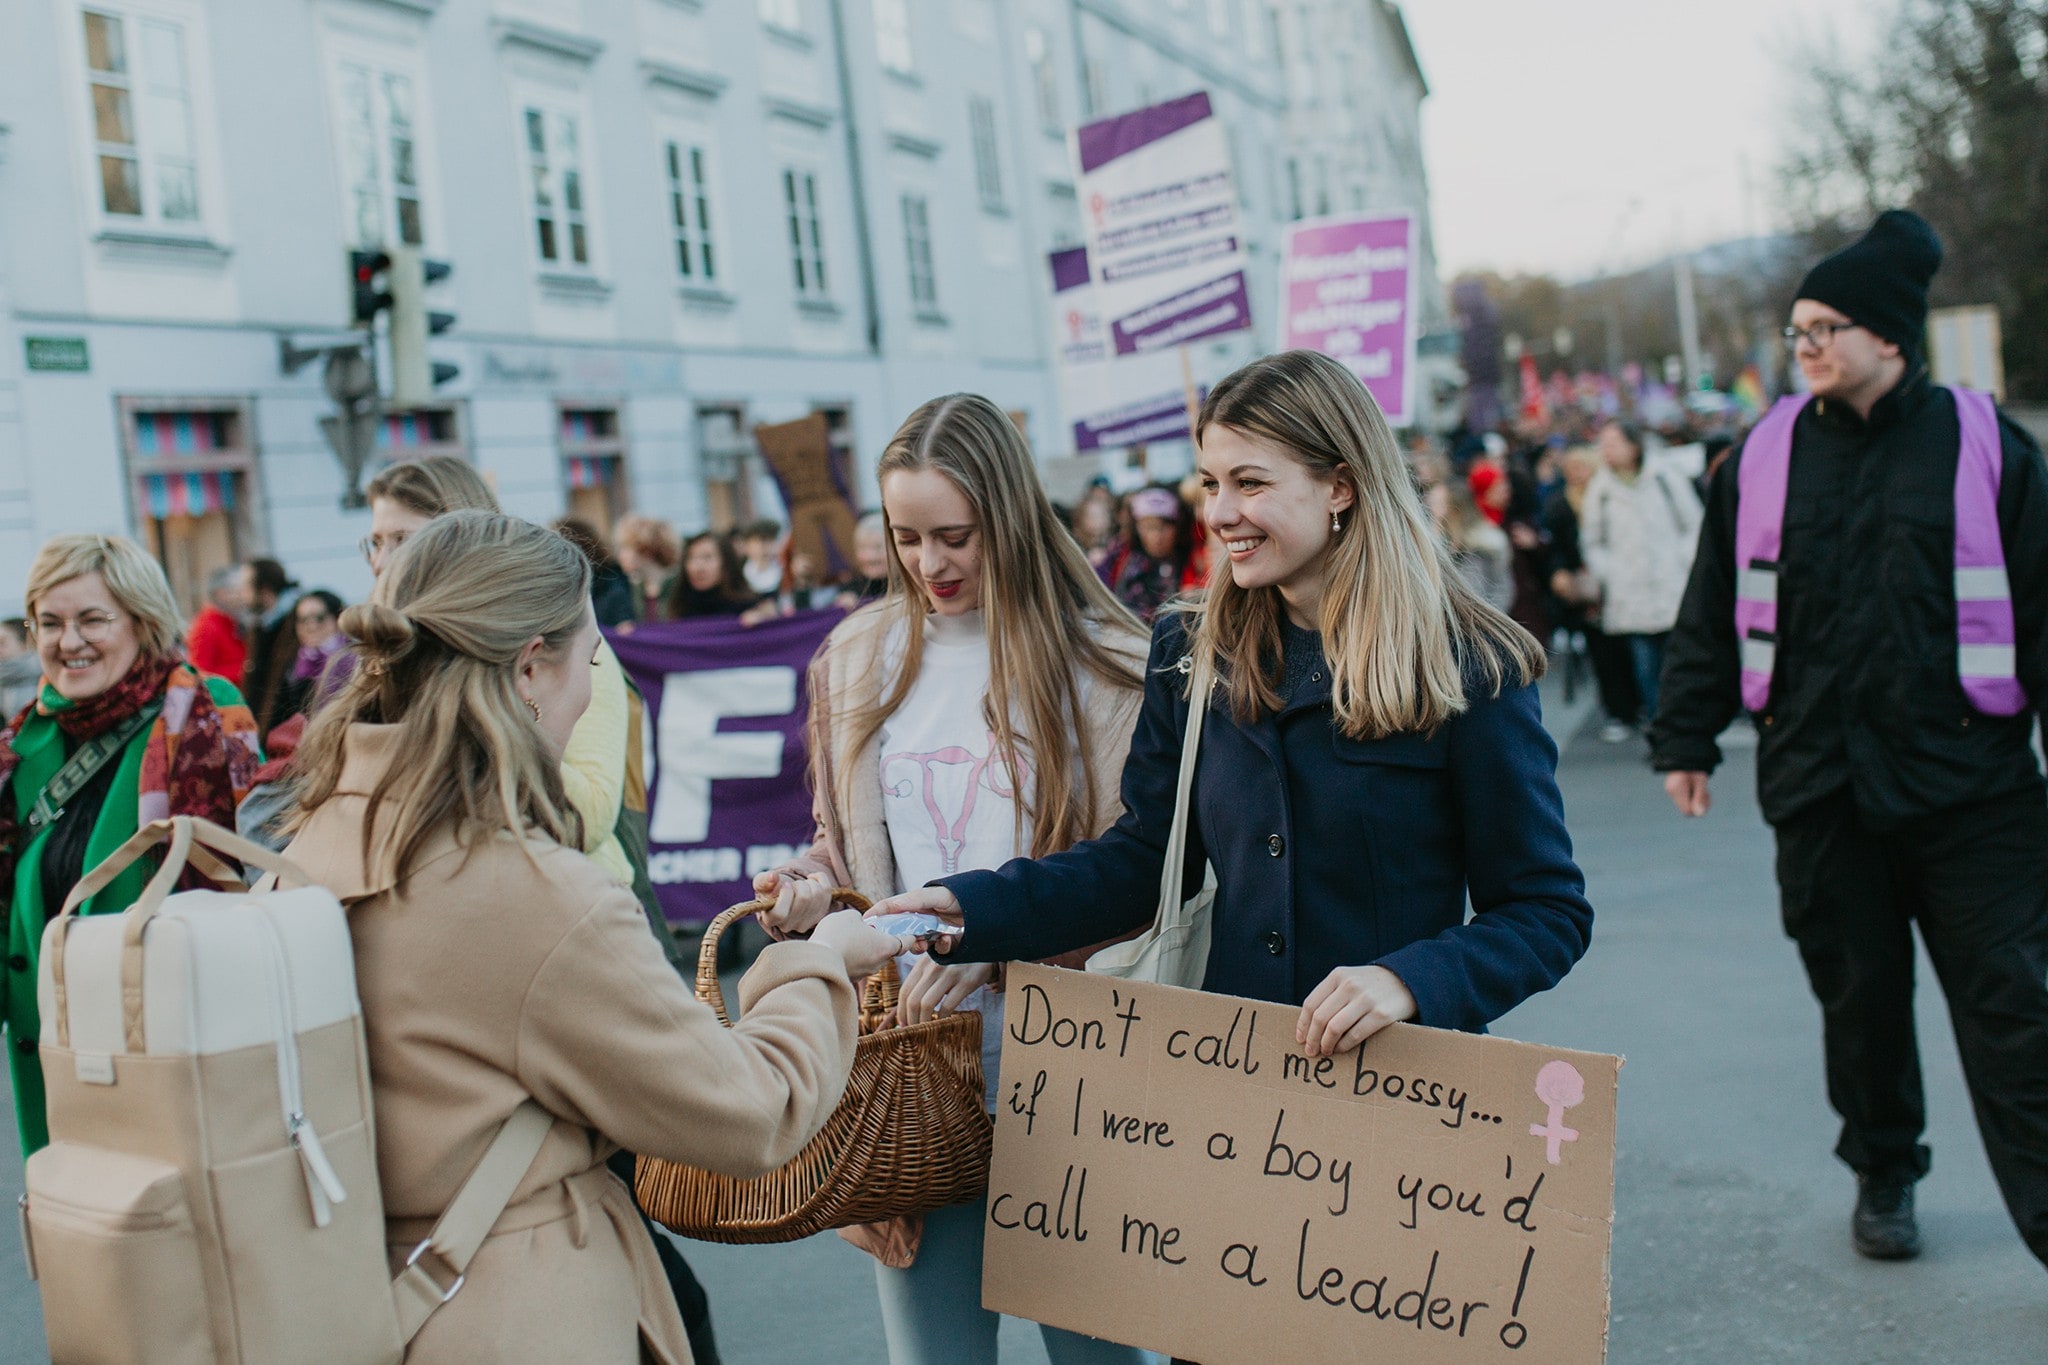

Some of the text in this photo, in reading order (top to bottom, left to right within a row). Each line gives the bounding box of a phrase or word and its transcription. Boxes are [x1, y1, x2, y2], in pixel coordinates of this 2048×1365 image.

[1010, 983, 1142, 1058] Don't
[1166, 1006, 1260, 1075] call
[1283, 1052, 1337, 1089] me
[1008, 1069, 1047, 1136] if
[1103, 1109, 1175, 1148] were
[1207, 1132, 1237, 1160] a
[1263, 1108, 1352, 1217] boy
[1397, 1154, 1545, 1232] you'd
[990, 1164, 1536, 1350] call me a leader!
